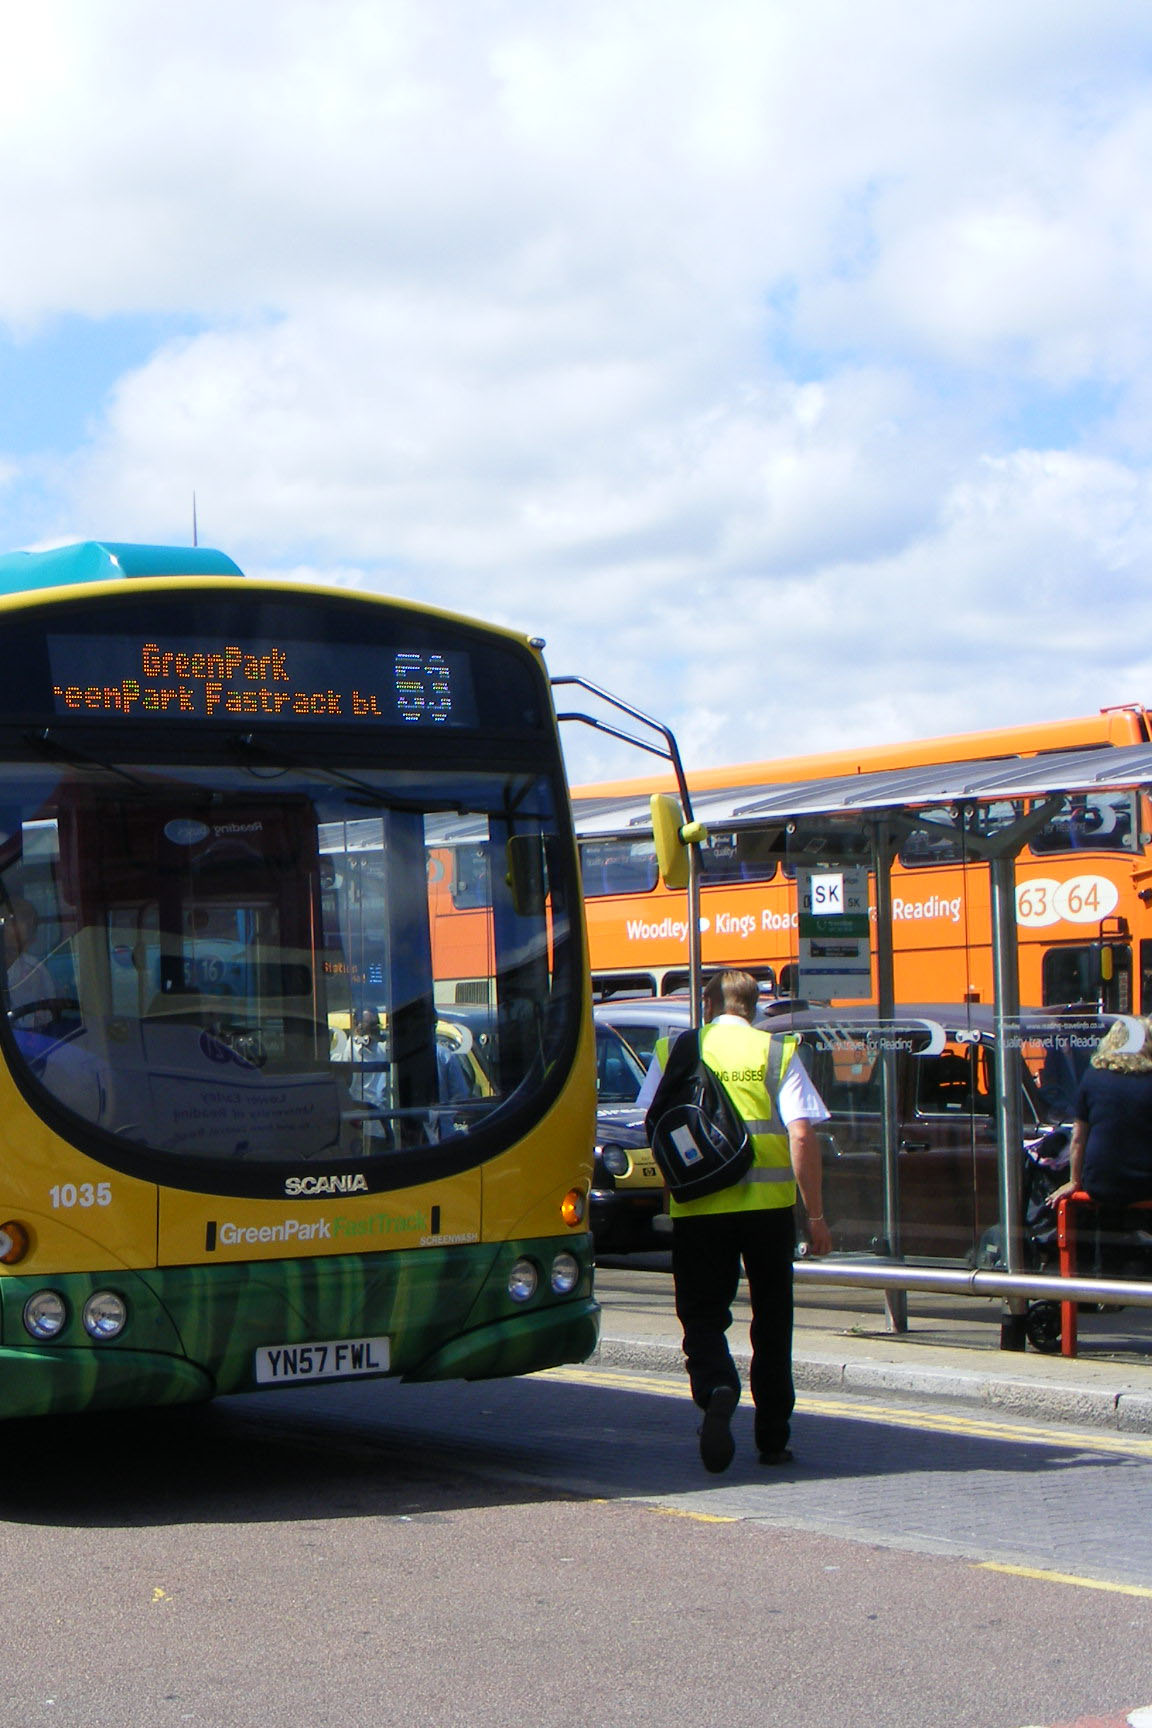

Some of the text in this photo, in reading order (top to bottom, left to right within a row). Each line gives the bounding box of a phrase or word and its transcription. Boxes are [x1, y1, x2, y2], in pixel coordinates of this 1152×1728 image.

[141, 643, 289, 681] GreenPark
[205, 682, 342, 715] Fastrack
[815, 885, 840, 903] SK
[1018, 887, 1047, 918] 63
[1067, 883, 1101, 914] 64
[626, 917, 688, 943] Woodley
[715, 913, 756, 938] Kings
[892, 896, 961, 922] Reading
[879, 1037, 913, 1053] Reading
[1029, 1036, 1054, 1048] travel
[1055, 1034, 1069, 1050] for
[731, 1070, 764, 1082] BUSES
[49, 1183, 112, 1208] 1035
[285, 1174, 368, 1195] SCANIA
[219, 1210, 427, 1244] GreenPark FastTrack
[419, 1233, 479, 1246] SCREENWASH
[267, 1343, 380, 1377] YN57 FWL
